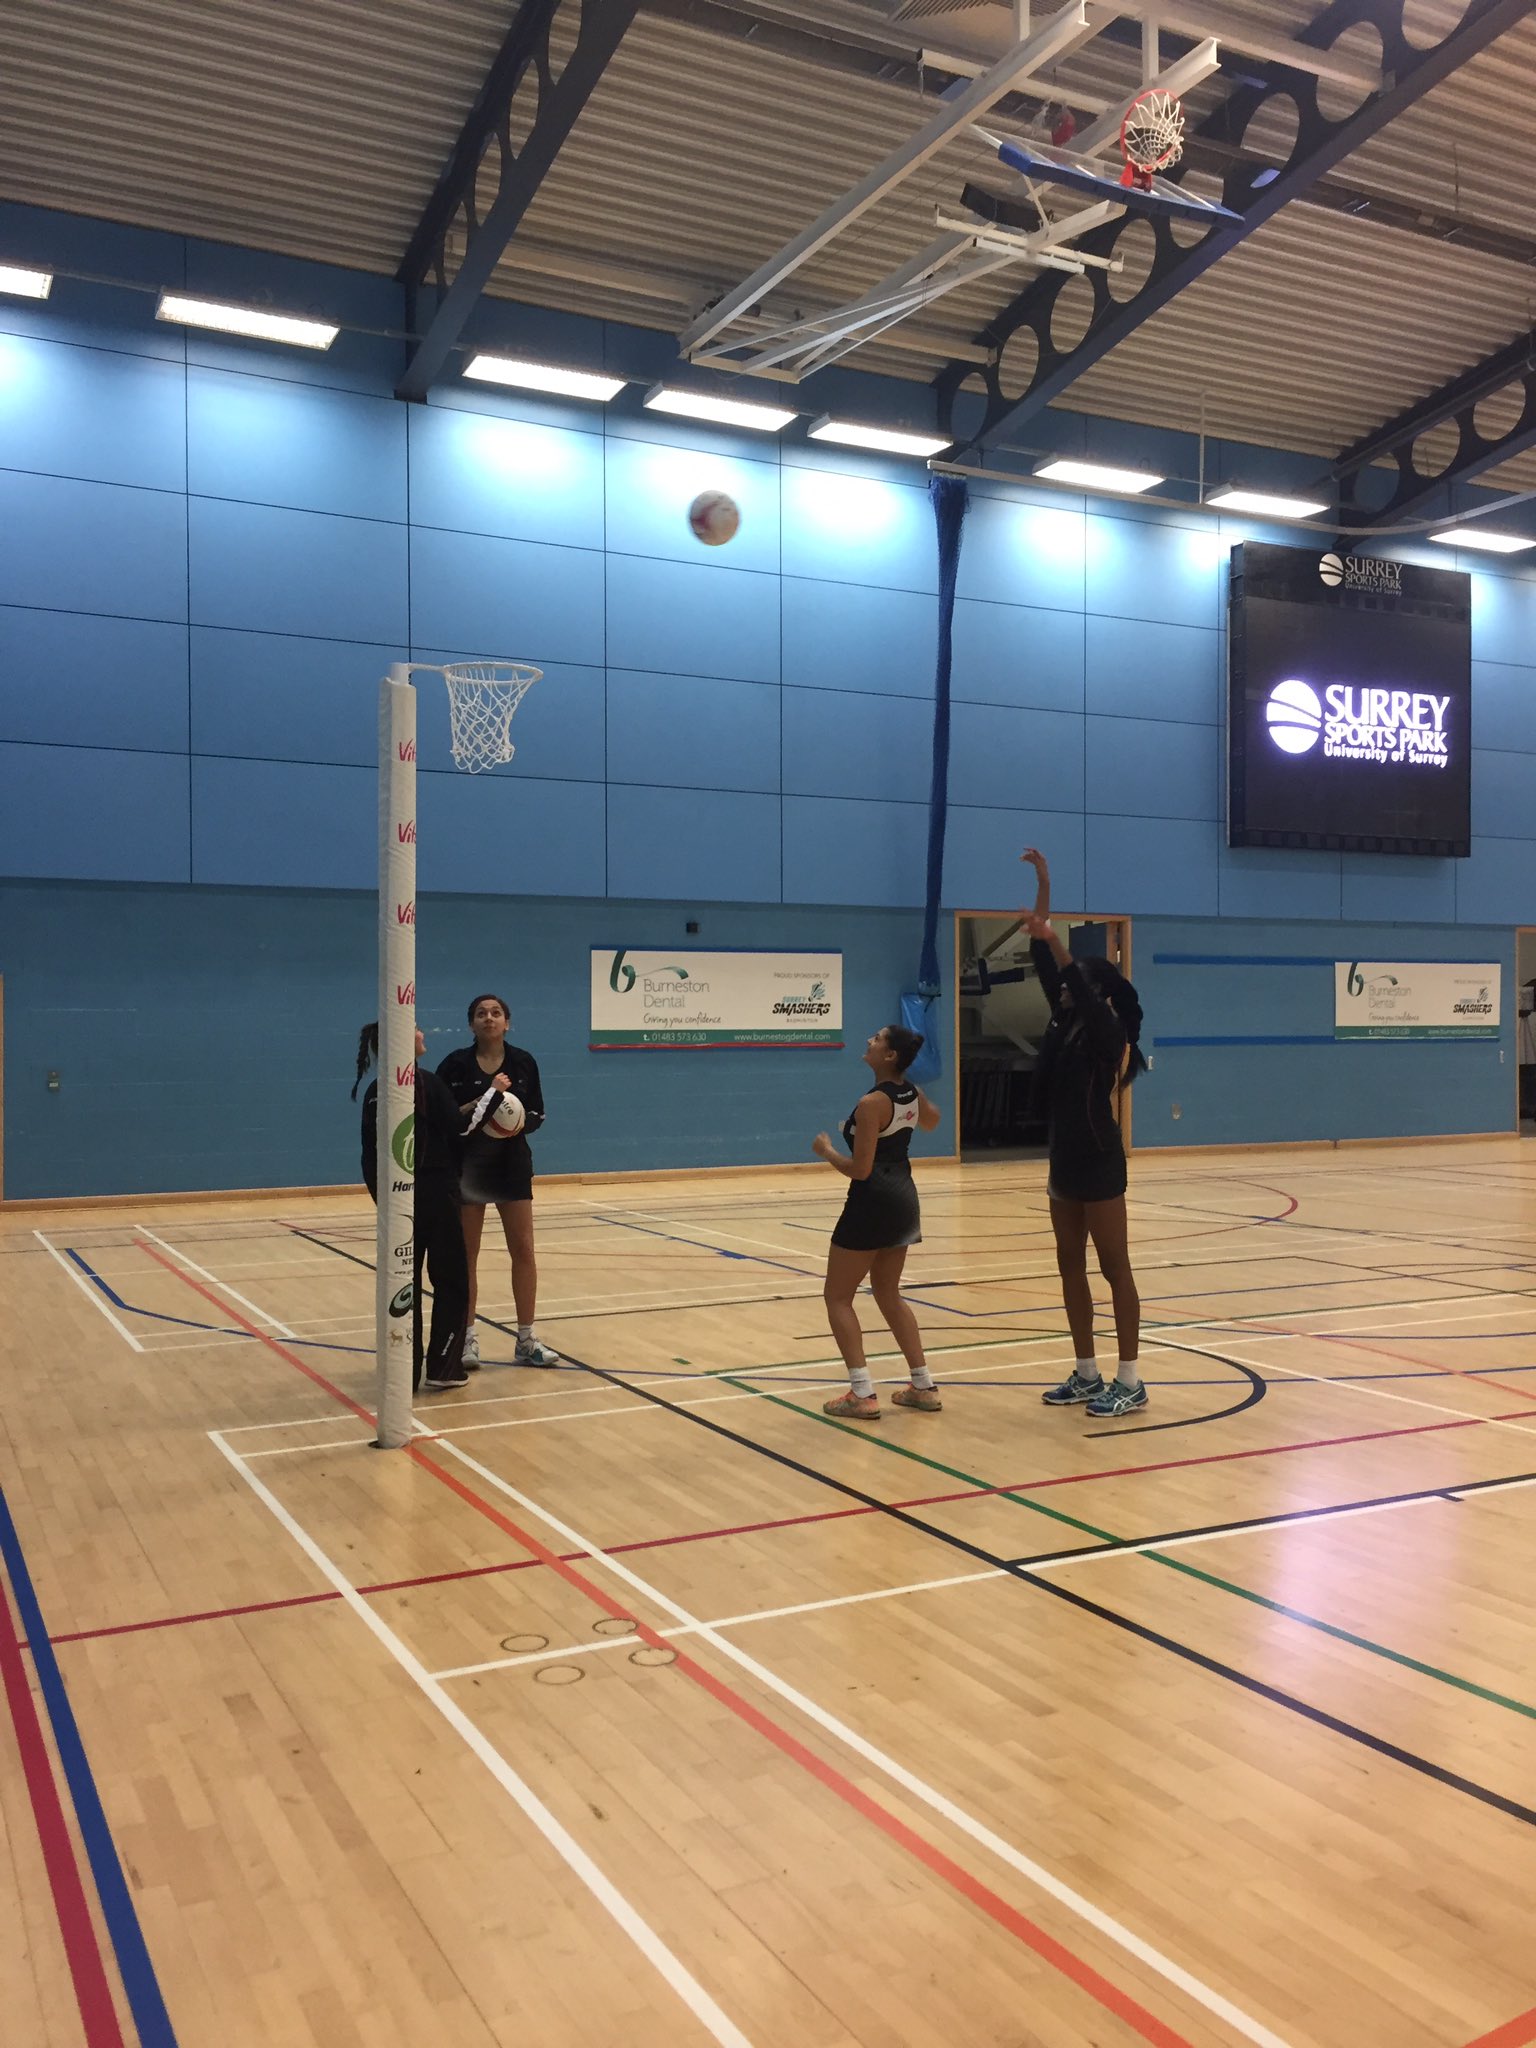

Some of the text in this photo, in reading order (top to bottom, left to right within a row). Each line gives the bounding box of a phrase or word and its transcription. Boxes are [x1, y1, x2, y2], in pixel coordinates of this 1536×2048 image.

[1345, 556, 1402, 579] SURREY
[1345, 572, 1402, 590] SPORTS PARK
[1345, 582, 1374, 592] University
[1384, 588, 1402, 596] Surrey
[1324, 684, 1450, 732] SURREY
[1324, 722, 1448, 753] SPORTS PARK
[1324, 743, 1448, 768] University of Surrey
[643, 979, 710, 992] Burneston
[643, 994, 686, 1008] Dental
[772, 1003, 831, 1016] SMASHERS
[1453, 1004, 1493, 1015] SMASHERS
[643, 1011, 722, 1028] Giving you confidence
